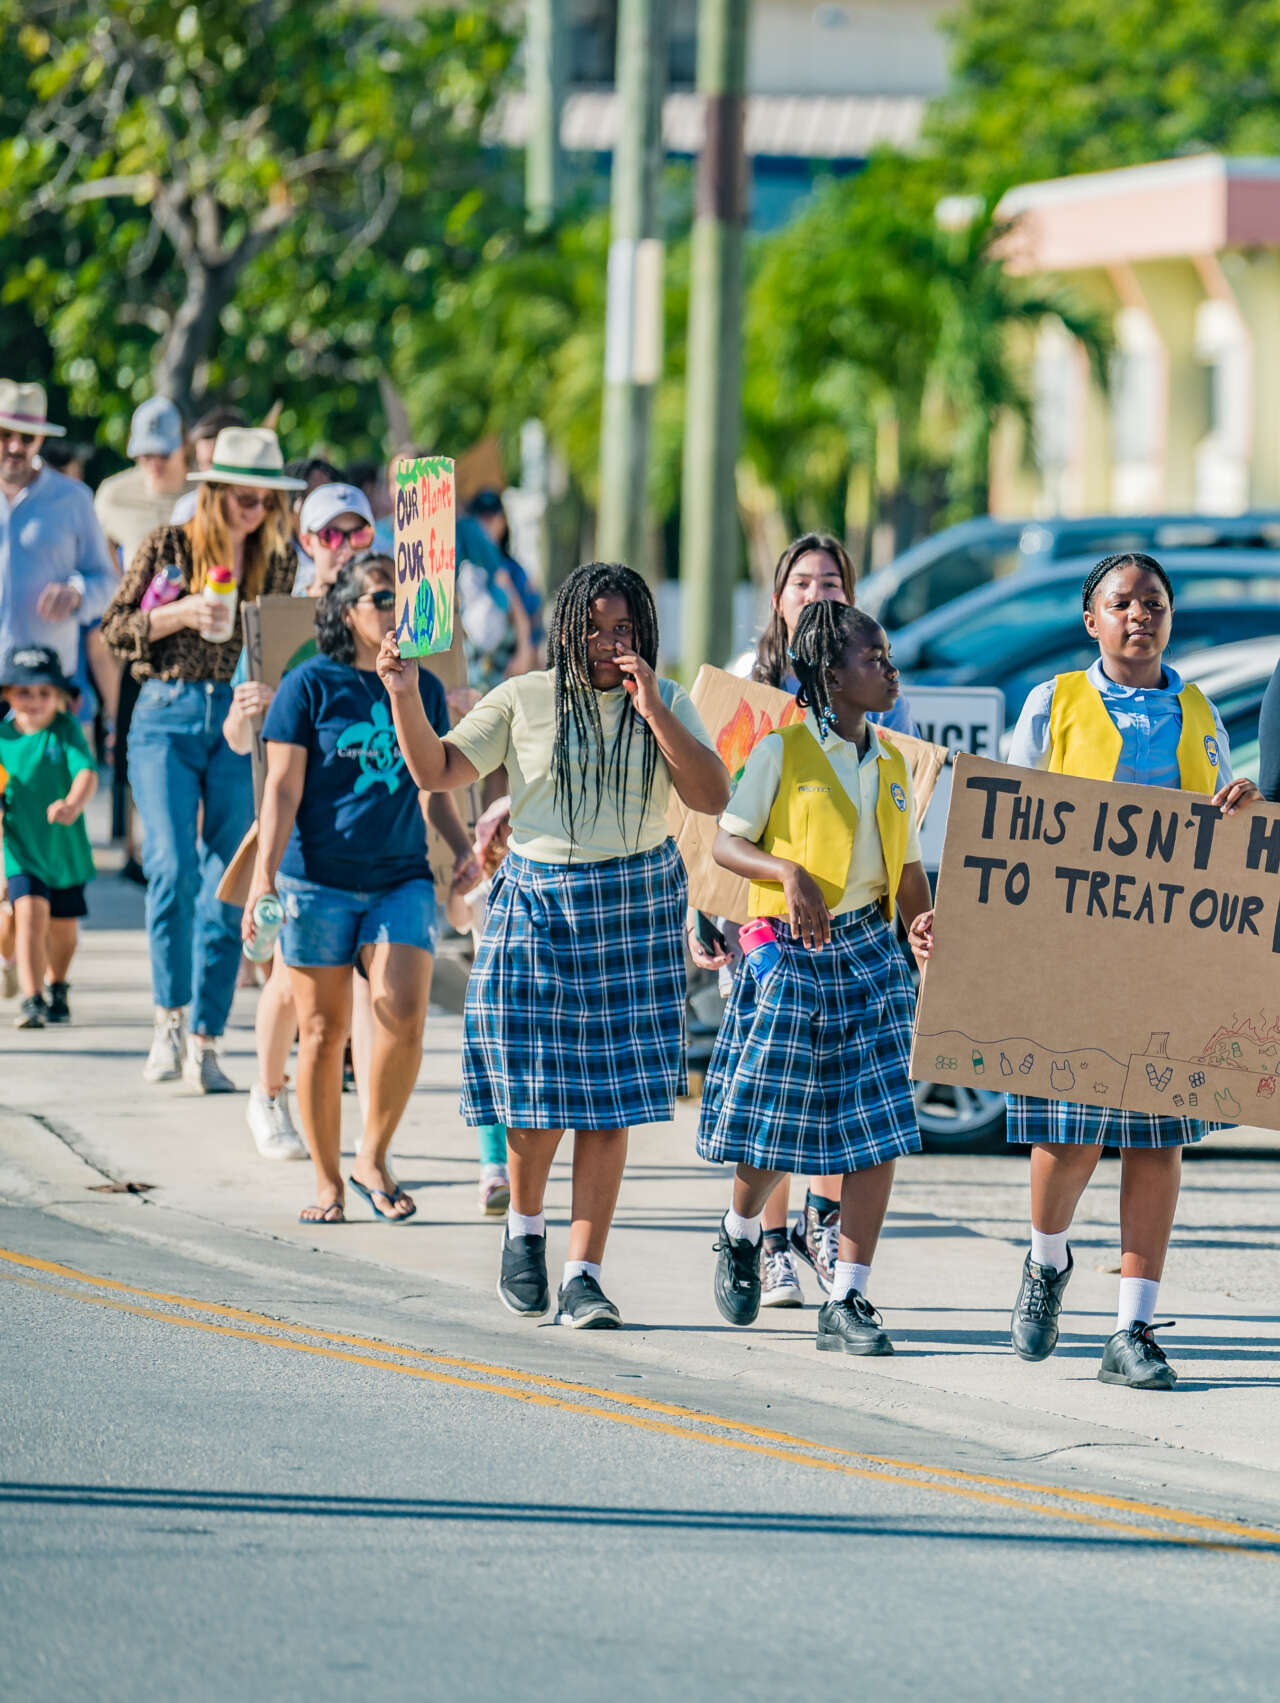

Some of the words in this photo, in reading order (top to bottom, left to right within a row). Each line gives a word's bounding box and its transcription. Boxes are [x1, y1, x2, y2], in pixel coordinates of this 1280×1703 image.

[397, 486, 419, 531] OUR
[421, 476, 452, 522] Planet
[398, 540, 426, 584] OUR
[966, 776, 1076, 845] THIS
[1093, 802, 1223, 871] ISN'T
[963, 855, 1031, 906] TO
[1055, 865, 1185, 924] TREAT
[1189, 887, 1265, 936] OUR
